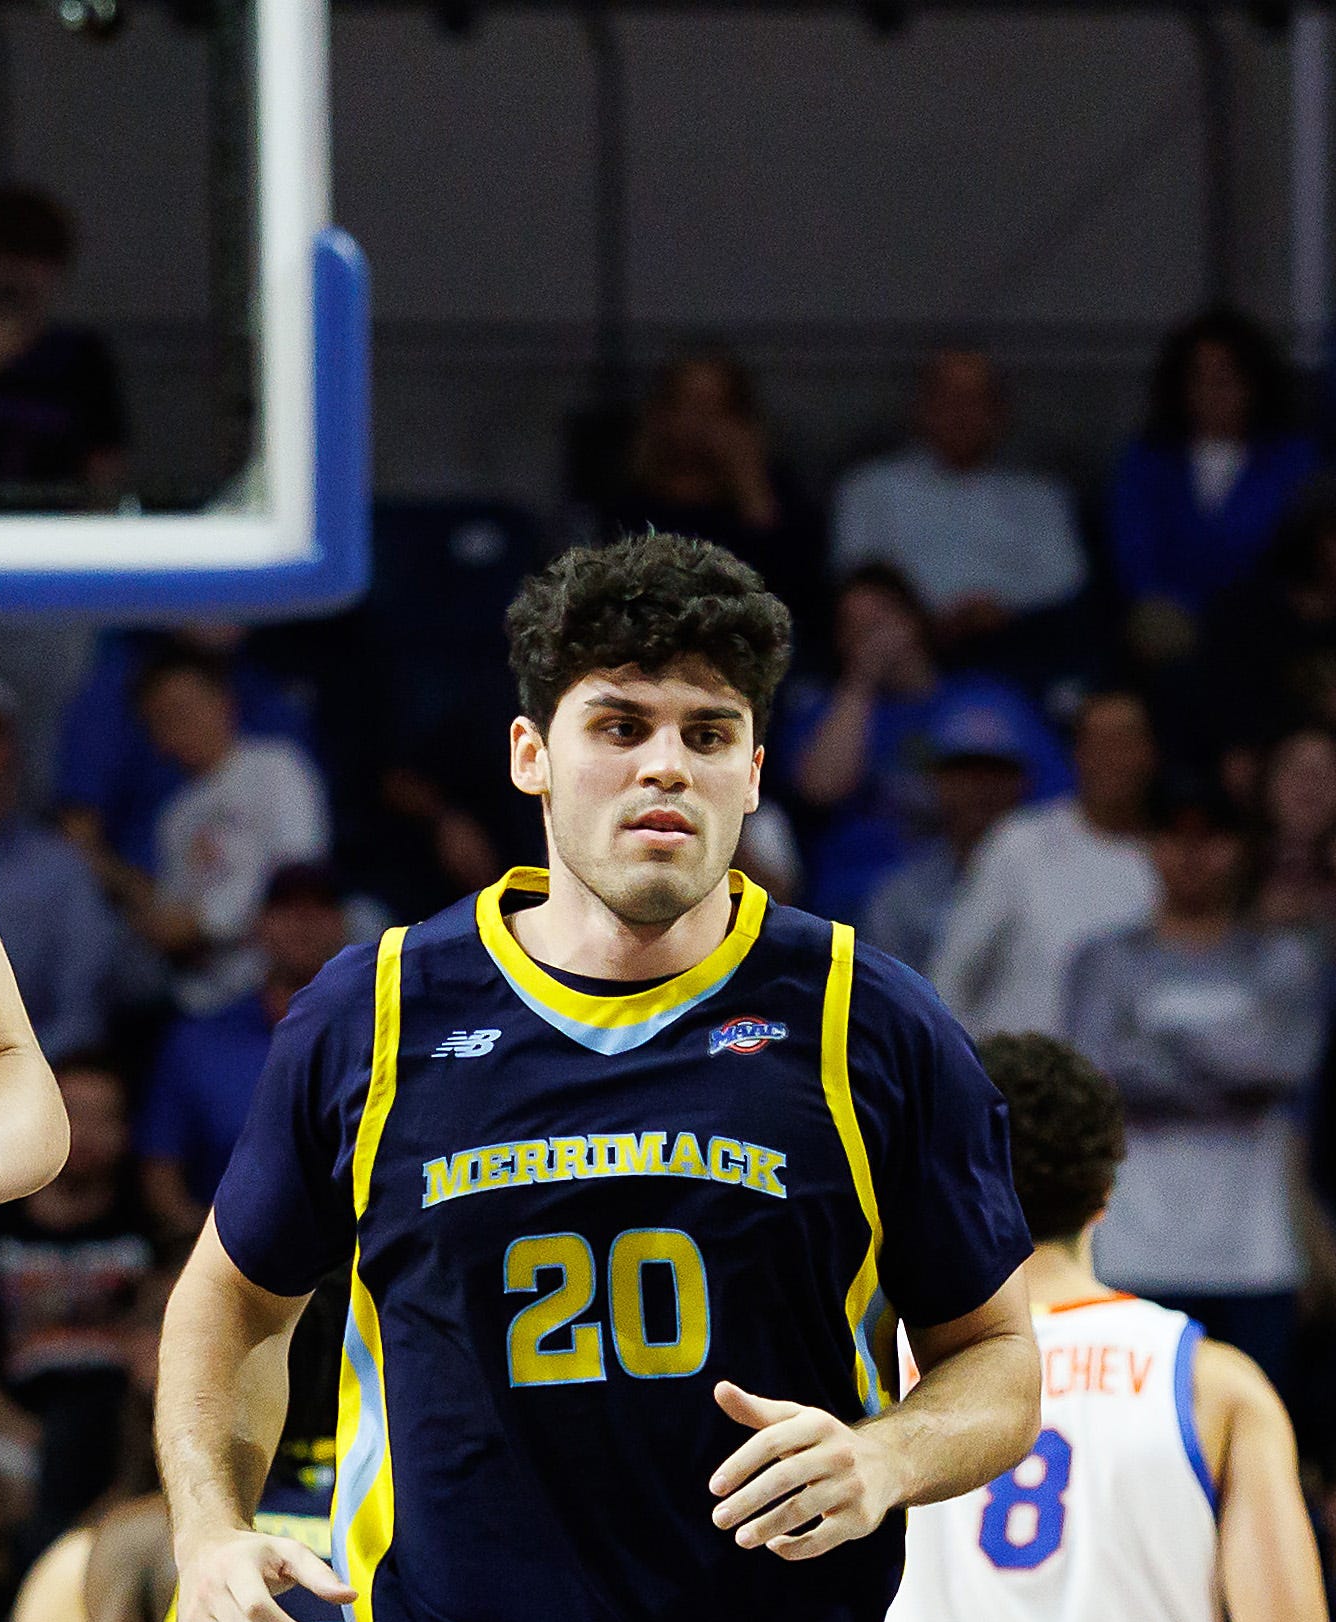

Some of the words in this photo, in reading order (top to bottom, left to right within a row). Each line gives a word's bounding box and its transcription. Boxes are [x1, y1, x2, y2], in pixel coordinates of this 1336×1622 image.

[421, 1131, 787, 1209] MERRIMACK
[502, 1227, 711, 1388] 20
[979, 1427, 1072, 1570] 8
